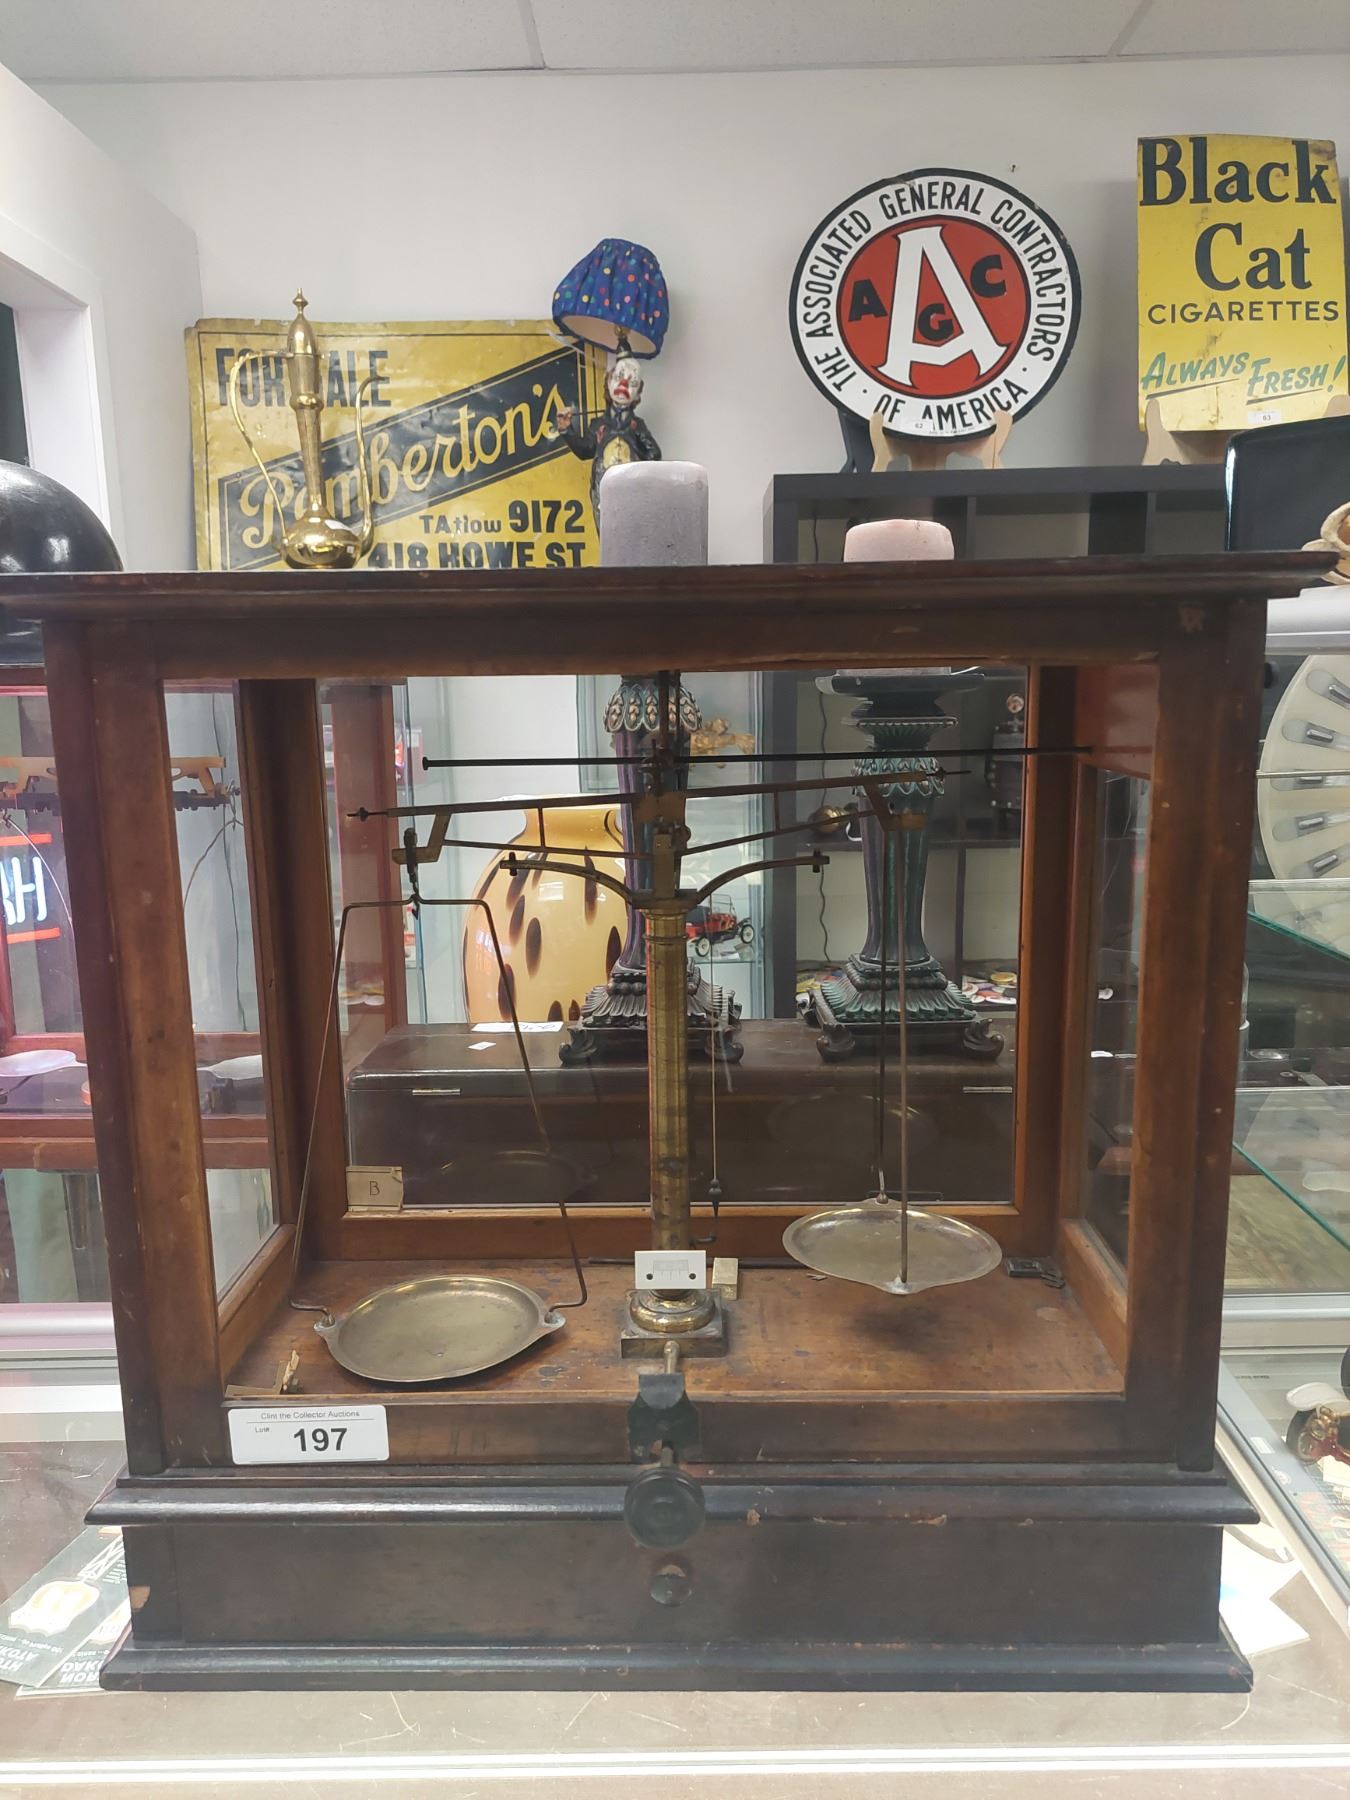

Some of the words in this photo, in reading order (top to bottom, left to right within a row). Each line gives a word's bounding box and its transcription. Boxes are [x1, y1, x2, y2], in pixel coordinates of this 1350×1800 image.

[1138, 136, 1337, 206] Black
[878, 181, 985, 221] GENERAL
[803, 209, 873, 340] ASSOCIATED
[1194, 221, 1313, 291] Cat
[990, 199, 1067, 363] CONTRACTORS
[1148, 301, 1339, 325] CIGARETTES
[321, 349, 392, 407] ALE
[814, 346, 857, 392] THE
[1141, 352, 1250, 391] ALWAYS
[1247, 355, 1347, 396] FRESH!
[873, 393, 906, 423] OF
[921, 377, 1029, 431] AMERICA
[508, 500, 585, 533] 9172
[367, 542, 429, 568] 418
[438, 541, 535, 568] HOWE
[279, 1411, 291, 1420] the
[293, 1411, 326, 1419] Collector
[328, 1410, 360, 1418] Auctions
[293, 1427, 348, 1452] 197
